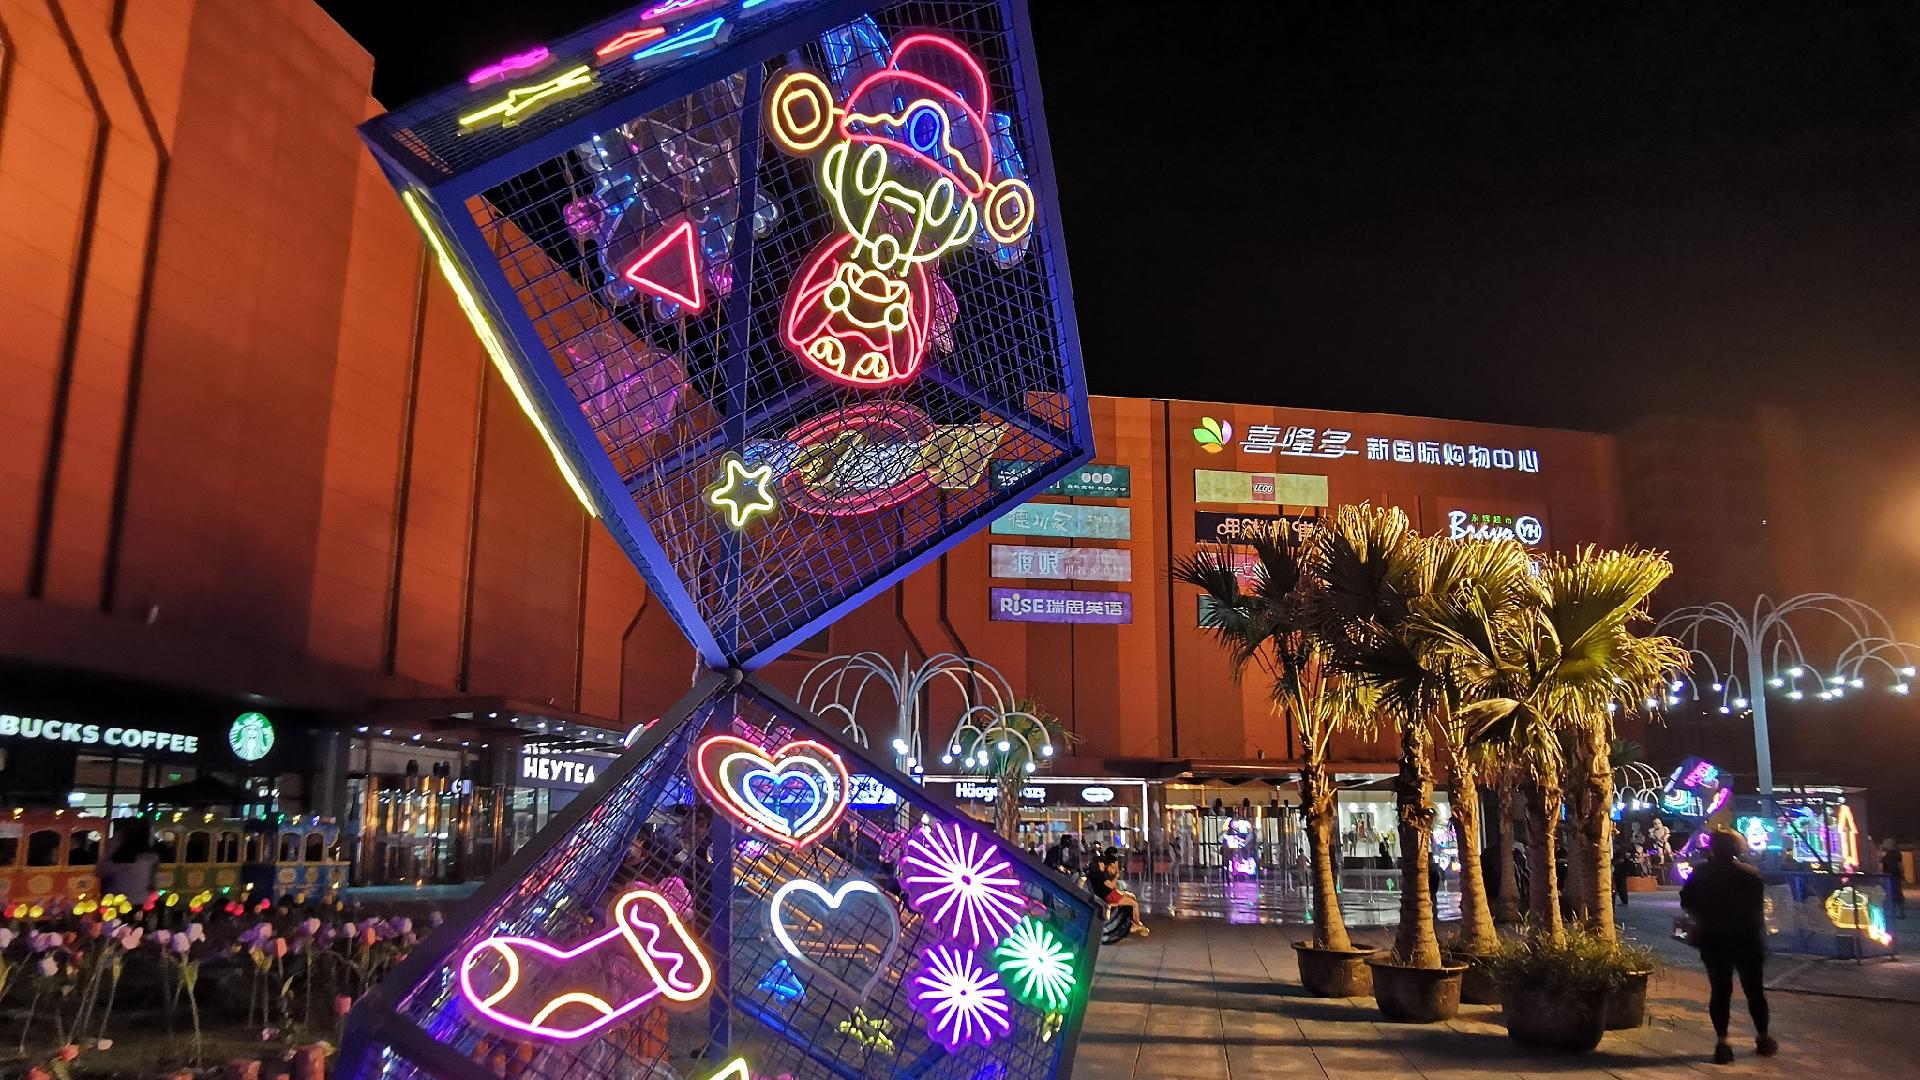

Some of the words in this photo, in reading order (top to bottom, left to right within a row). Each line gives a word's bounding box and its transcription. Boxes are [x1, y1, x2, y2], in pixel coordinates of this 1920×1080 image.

[1239, 425, 1359, 458] 喜隆多
[1366, 437, 1539, 473] 新国际购物中心
[1253, 483, 1274, 494] LEGO
[1045, 599, 1123, 616] 瑞思英语
[103, 727, 199, 754] COFFEE
